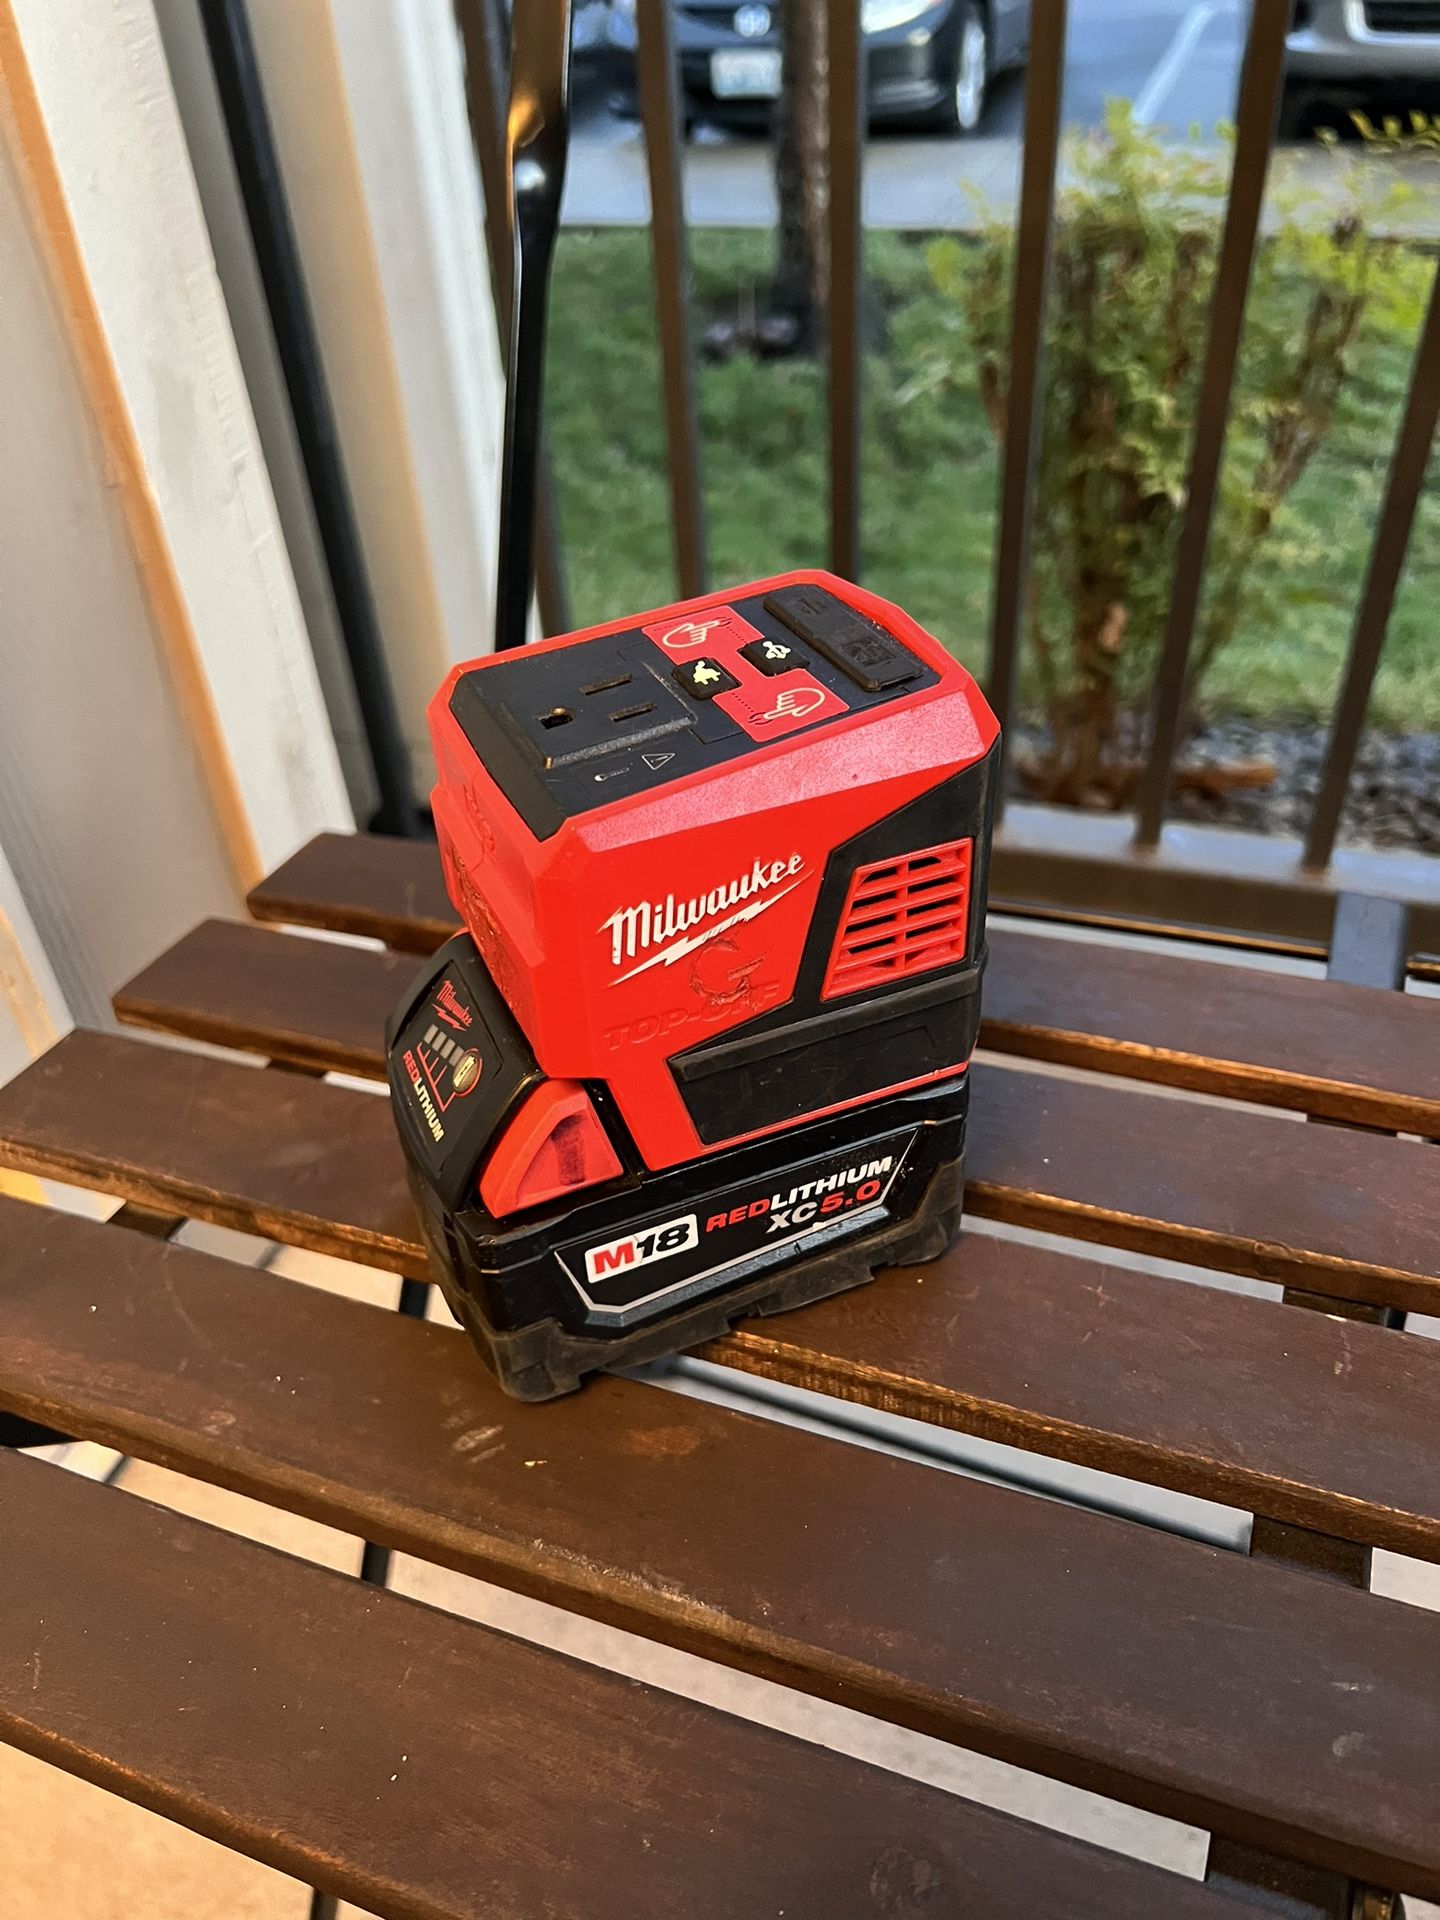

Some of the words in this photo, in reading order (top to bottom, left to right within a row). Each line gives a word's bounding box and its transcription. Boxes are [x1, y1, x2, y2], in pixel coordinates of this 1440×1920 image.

[597, 852, 805, 965] Milwaukee
[402, 1050, 445, 1142] REDLITHIUM
[705, 1156, 893, 1232] REDLITHIUM
[592, 1223, 691, 1275] M18
